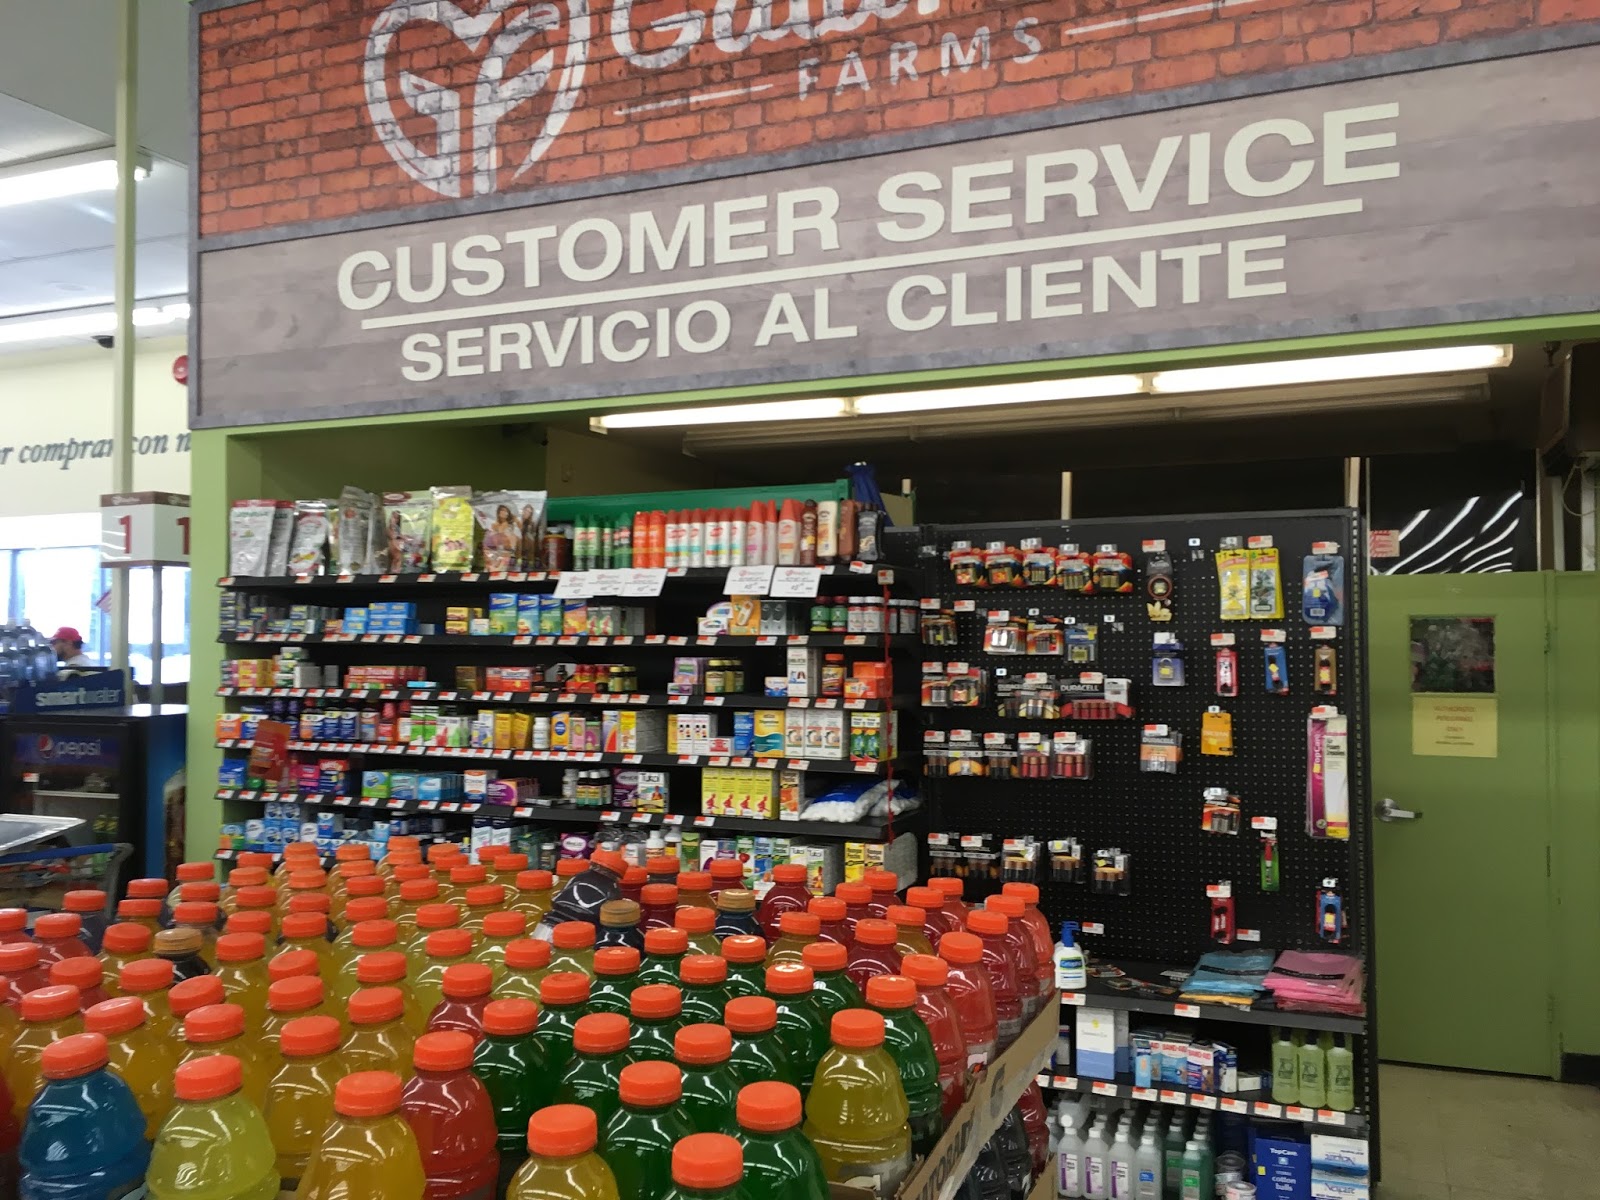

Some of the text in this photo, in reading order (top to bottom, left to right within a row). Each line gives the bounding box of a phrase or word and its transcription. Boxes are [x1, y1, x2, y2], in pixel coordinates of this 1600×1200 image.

[799, 17, 1042, 100] FARMS
[337, 102, 1400, 311] CUSTOMER SERVICE
[401, 235, 1287, 382] SERVICIO AL CLIENTE
[131, 433, 169, 455] on
[119, 515, 132, 554] 1
[176, 516, 191, 555] 1
[54, 739, 101, 759] pepsi
[1271, 1176, 1297, 1185] cotton
[1275, 1183, 1294, 1192] balls
